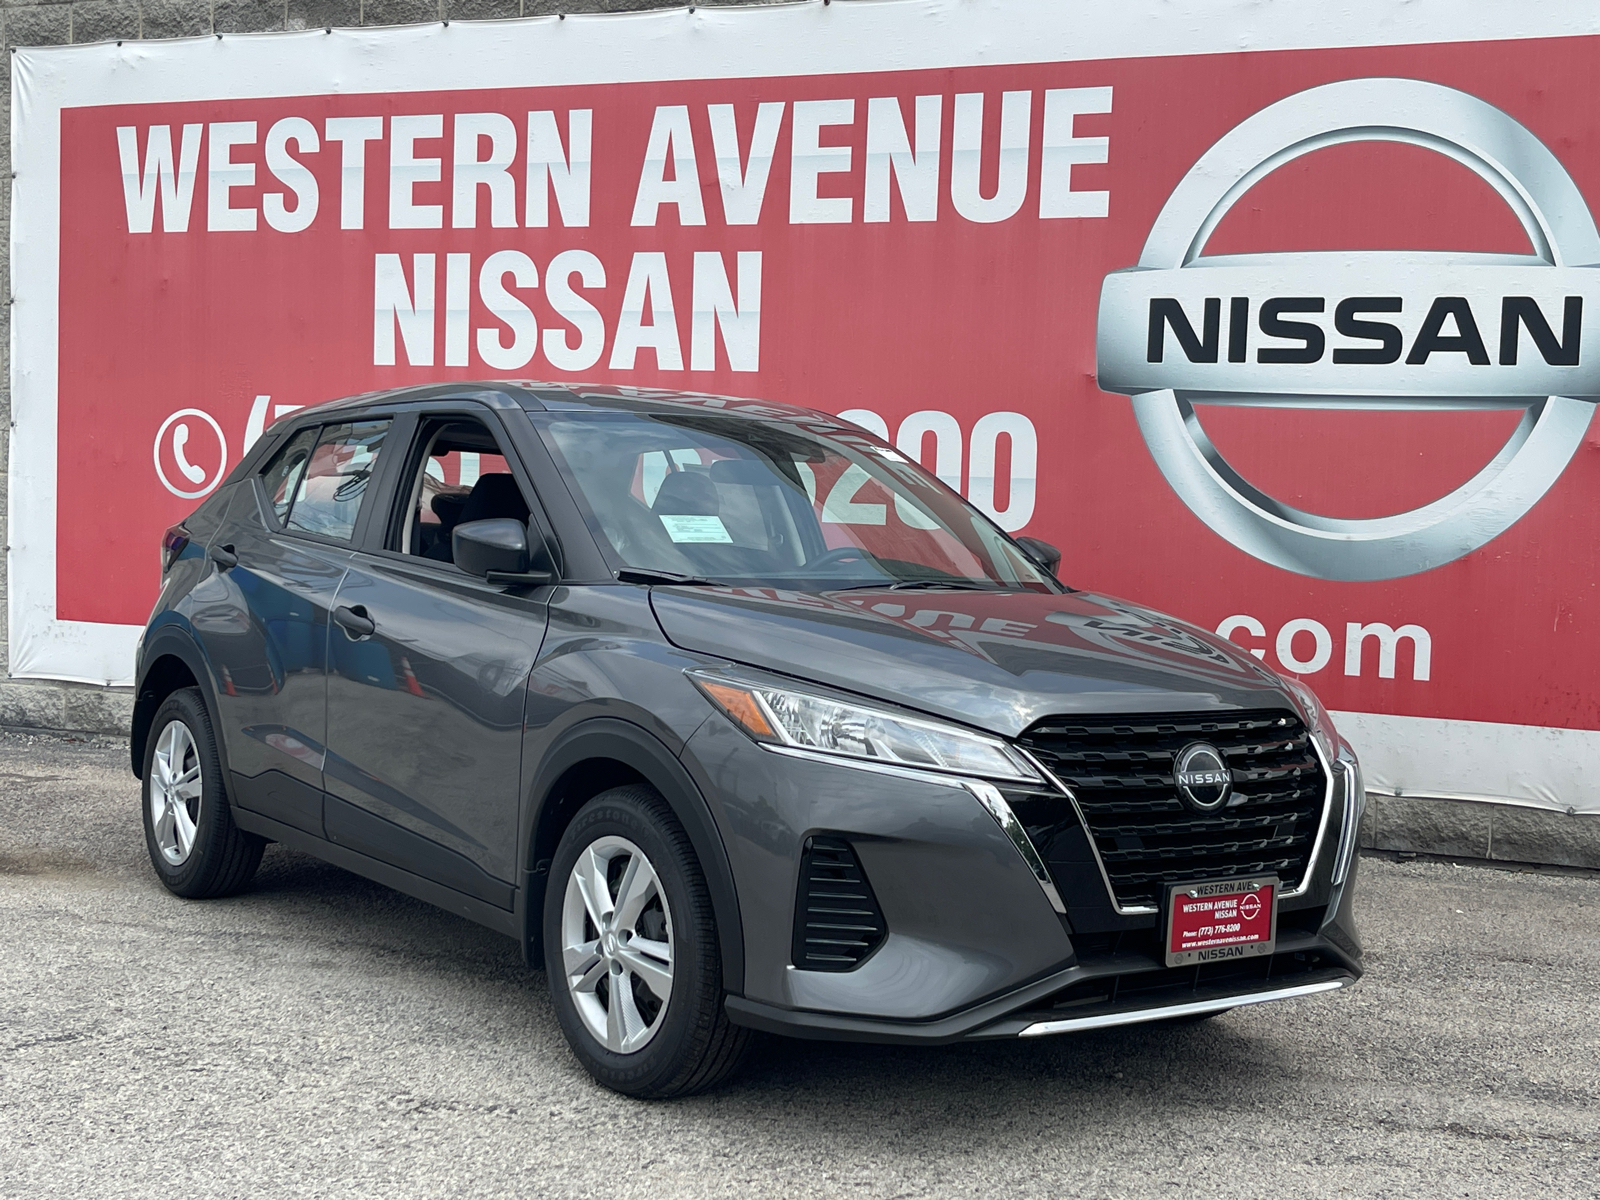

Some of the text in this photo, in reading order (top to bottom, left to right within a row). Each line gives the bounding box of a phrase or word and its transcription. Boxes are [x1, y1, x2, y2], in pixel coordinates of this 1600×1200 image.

[116, 86, 1114, 234] WESTERN AVENUE
[373, 250, 762, 372] NISSAN
[1147, 296, 1583, 366] NISSAN
[1178, 772, 1230, 785] NISSAN
[569, 808, 639, 841] Firestone
[1197, 883, 1234, 895] WESTERN
[1183, 900, 1237, 912] WESTERN AVENUE
[1215, 910, 1237, 919] NISSAN
[1198, 926, 1214, 937] (773)
[1215, 924, 1240, 933] 776-8200
[1182, 935, 1258, 948] www.westernavenissan.com
[1199, 947, 1243, 960] NISSAN
